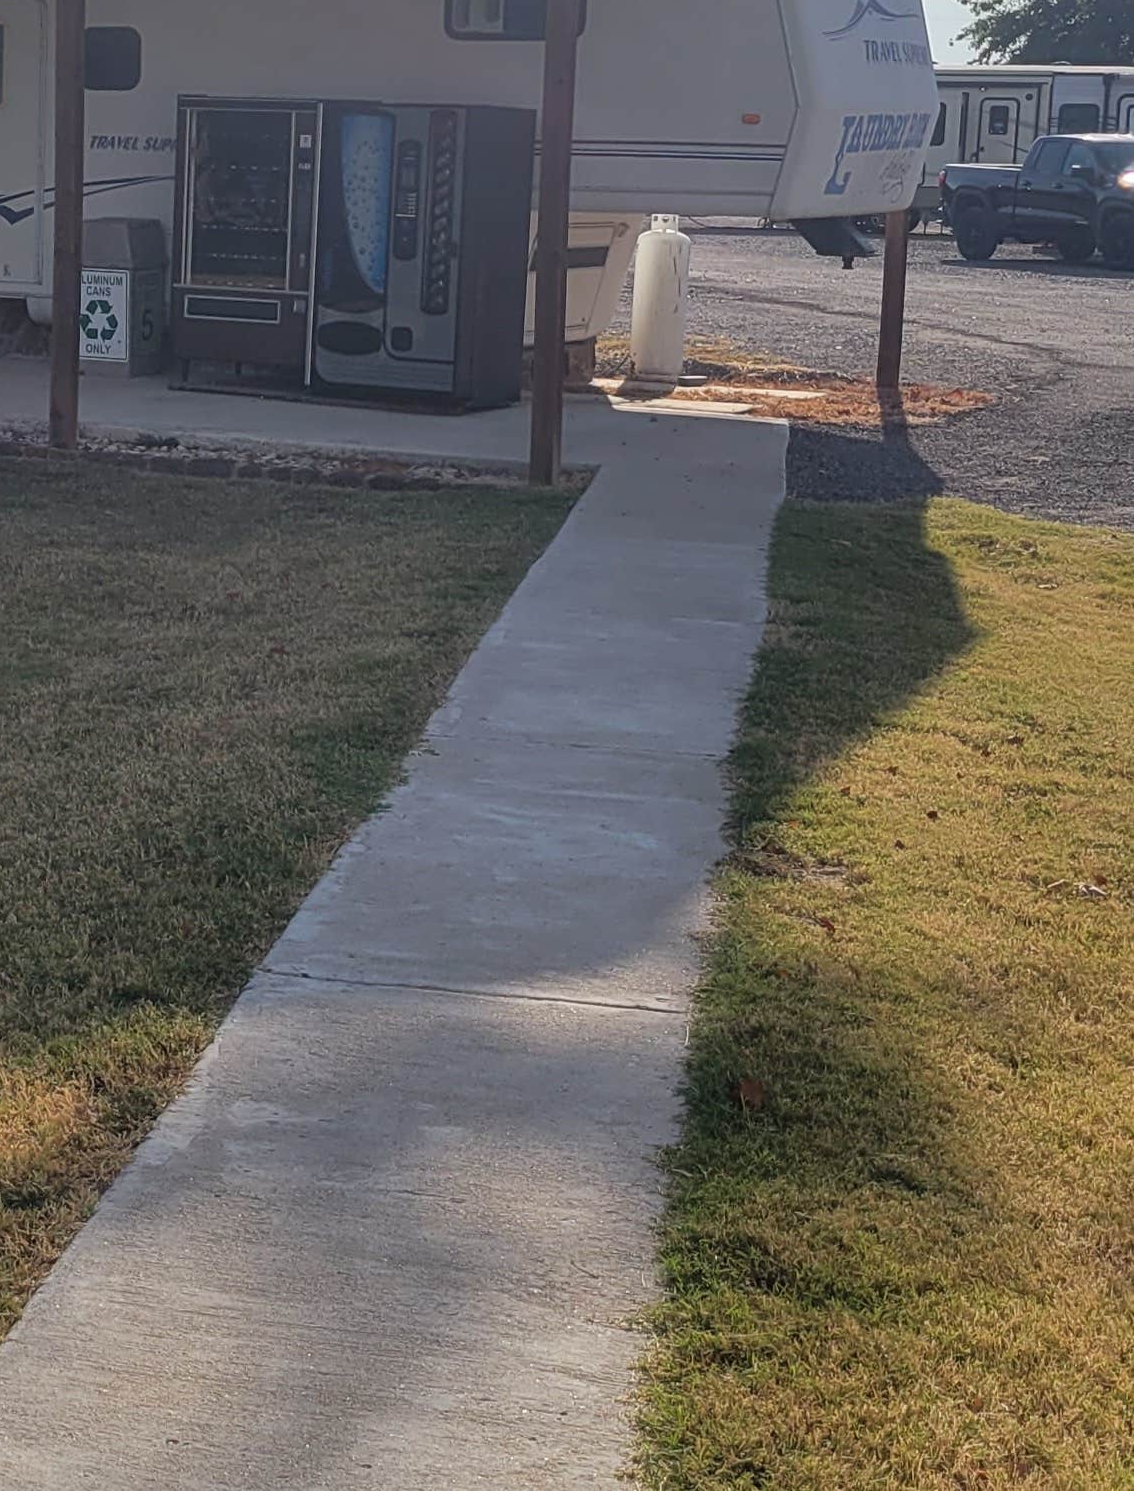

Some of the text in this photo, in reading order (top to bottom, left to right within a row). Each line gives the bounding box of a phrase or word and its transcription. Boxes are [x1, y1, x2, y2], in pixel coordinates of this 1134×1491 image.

[863, 39, 901, 62] TRAVEL
[89, 135, 139, 150] TRAVEL
[81, 275, 123, 286] LUMINUM
[86, 286, 112, 297] CANS
[85, 343, 112, 355] ONLY
